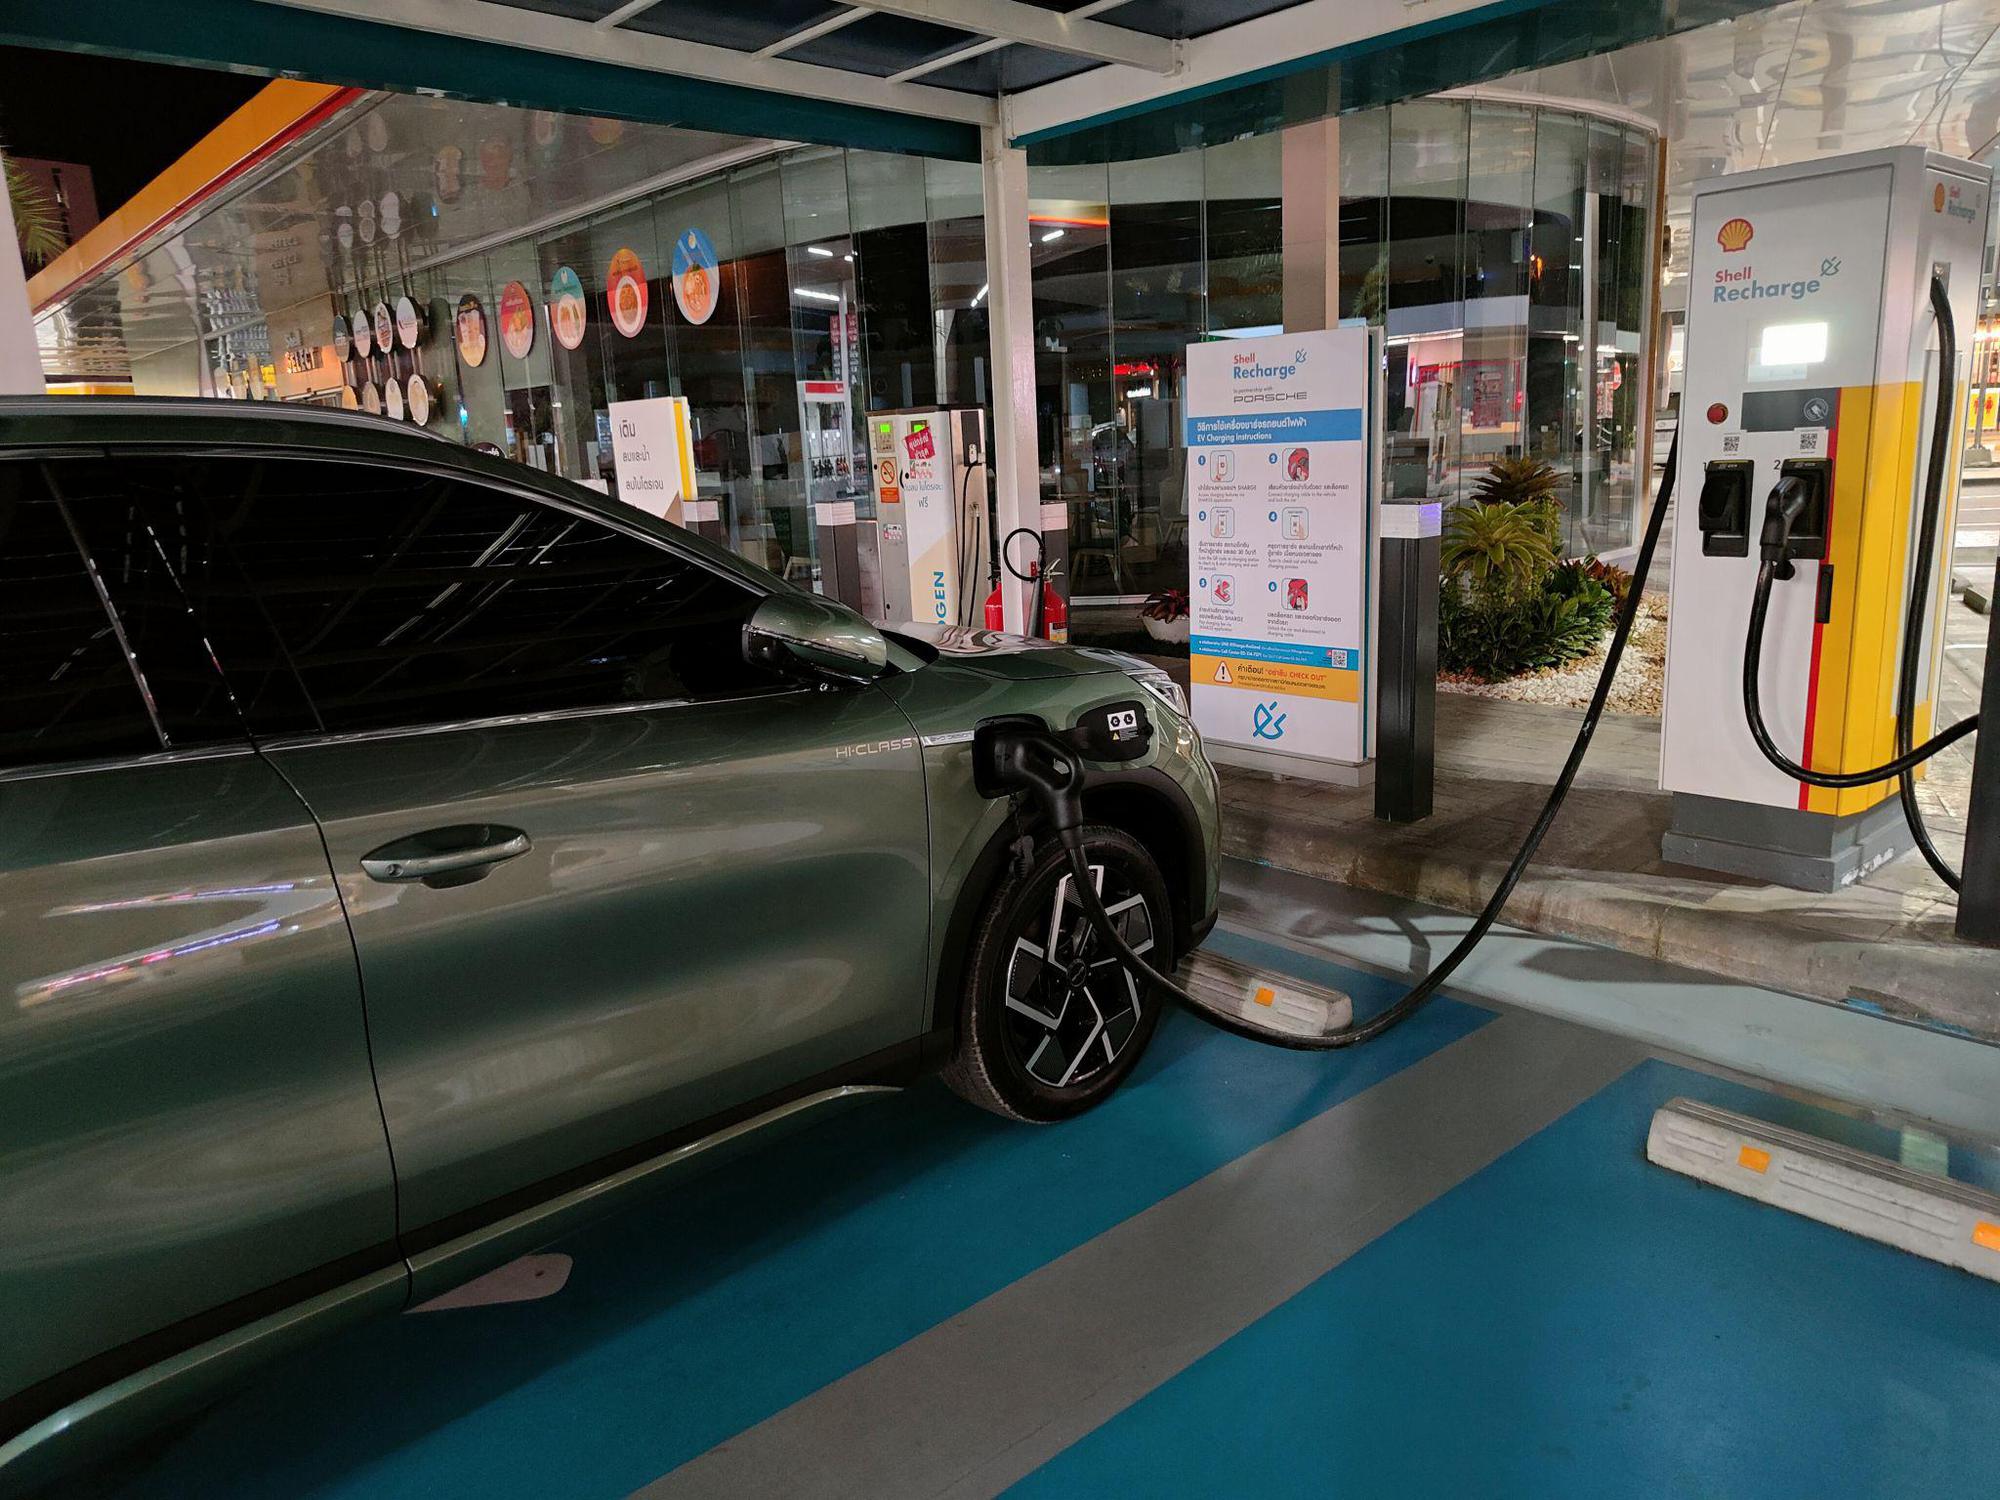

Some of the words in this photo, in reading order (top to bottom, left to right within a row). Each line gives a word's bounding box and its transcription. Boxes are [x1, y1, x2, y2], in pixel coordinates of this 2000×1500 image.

[1715, 266, 1752, 283] Shell
[1713, 280, 1820, 303] Recharge
[1233, 353, 1256, 364] Shell
[1233, 363, 1296, 380] Recharge
[1233, 391, 1307, 403] PORSCHE
[619, 419, 636, 438] เติม
[1197, 434, 1206, 442] EV
[1206, 433, 1235, 443] Charging
[1235, 432, 1272, 441] Instructions
[622, 444, 651, 462] ลมและน้ำ
[1773, 460, 1781, 470] 2
[626, 475, 664, 490] ลมไนโตรเจน
[1289, 671, 1310, 680] CHECK
